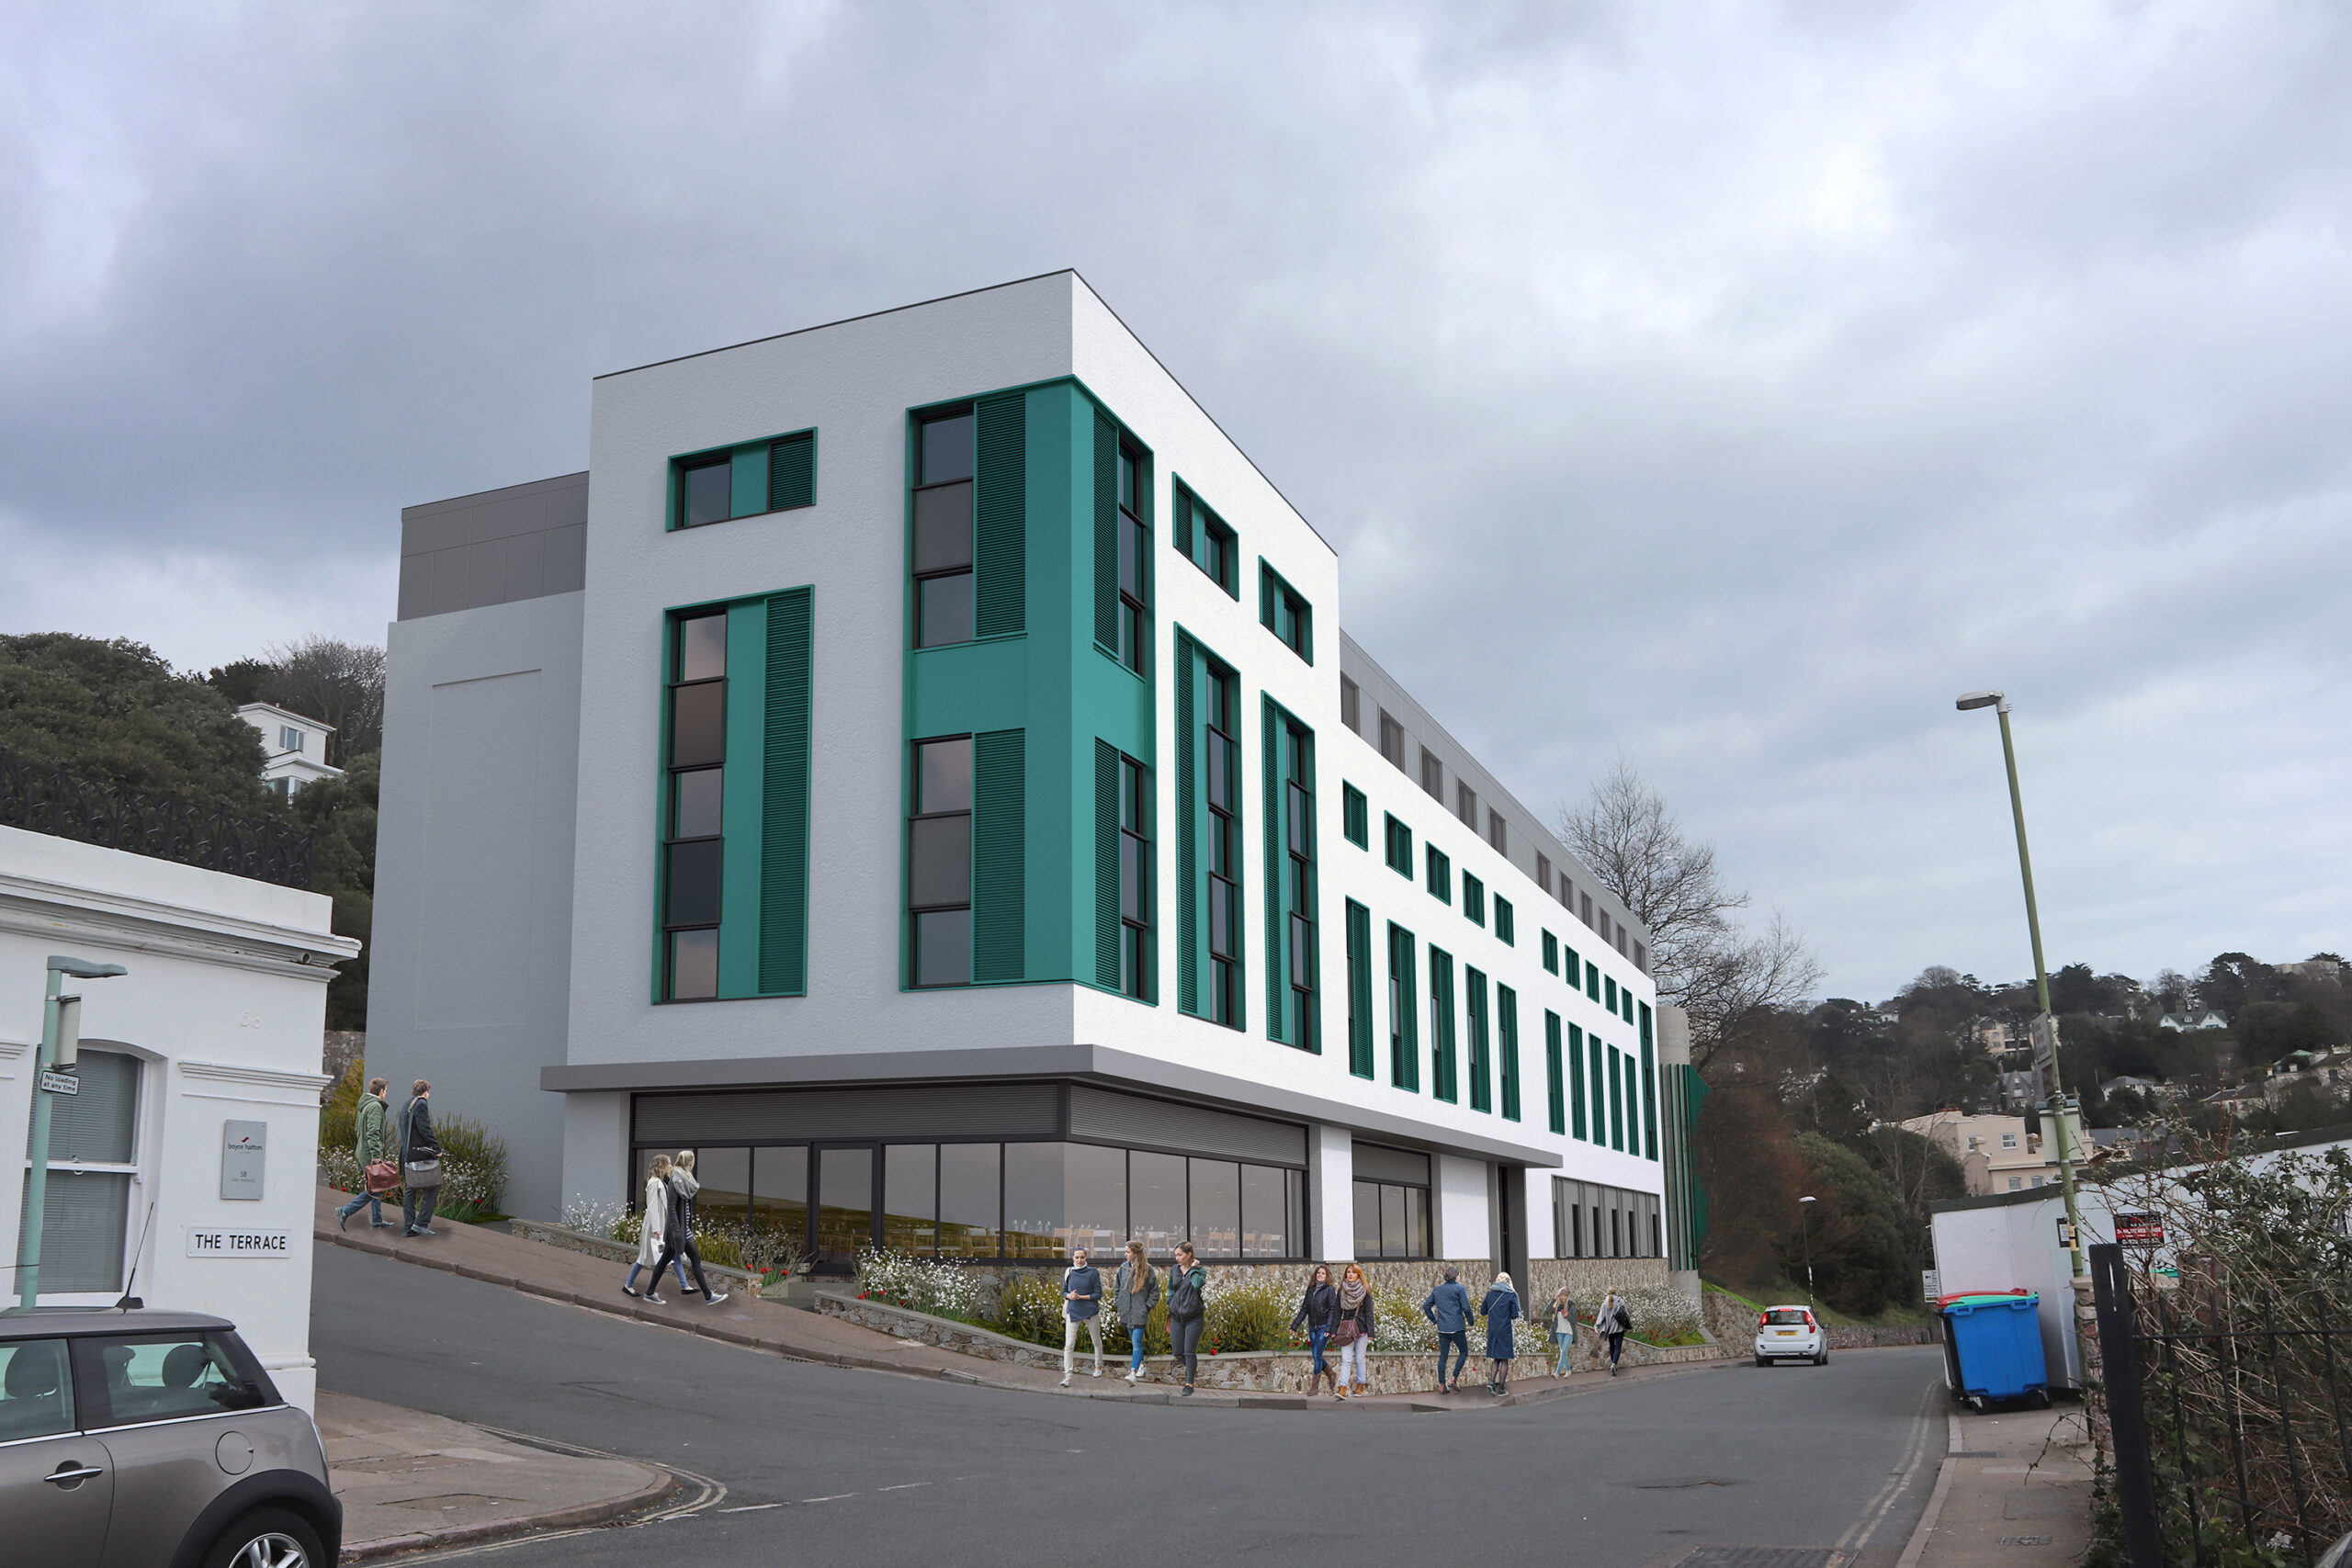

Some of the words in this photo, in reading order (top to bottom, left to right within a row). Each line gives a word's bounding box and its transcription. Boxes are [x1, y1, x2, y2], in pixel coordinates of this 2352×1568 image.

[55, 1076, 76, 1086] loading
[196, 1234, 221, 1249] THE
[229, 1235, 287, 1250] TERRACE
